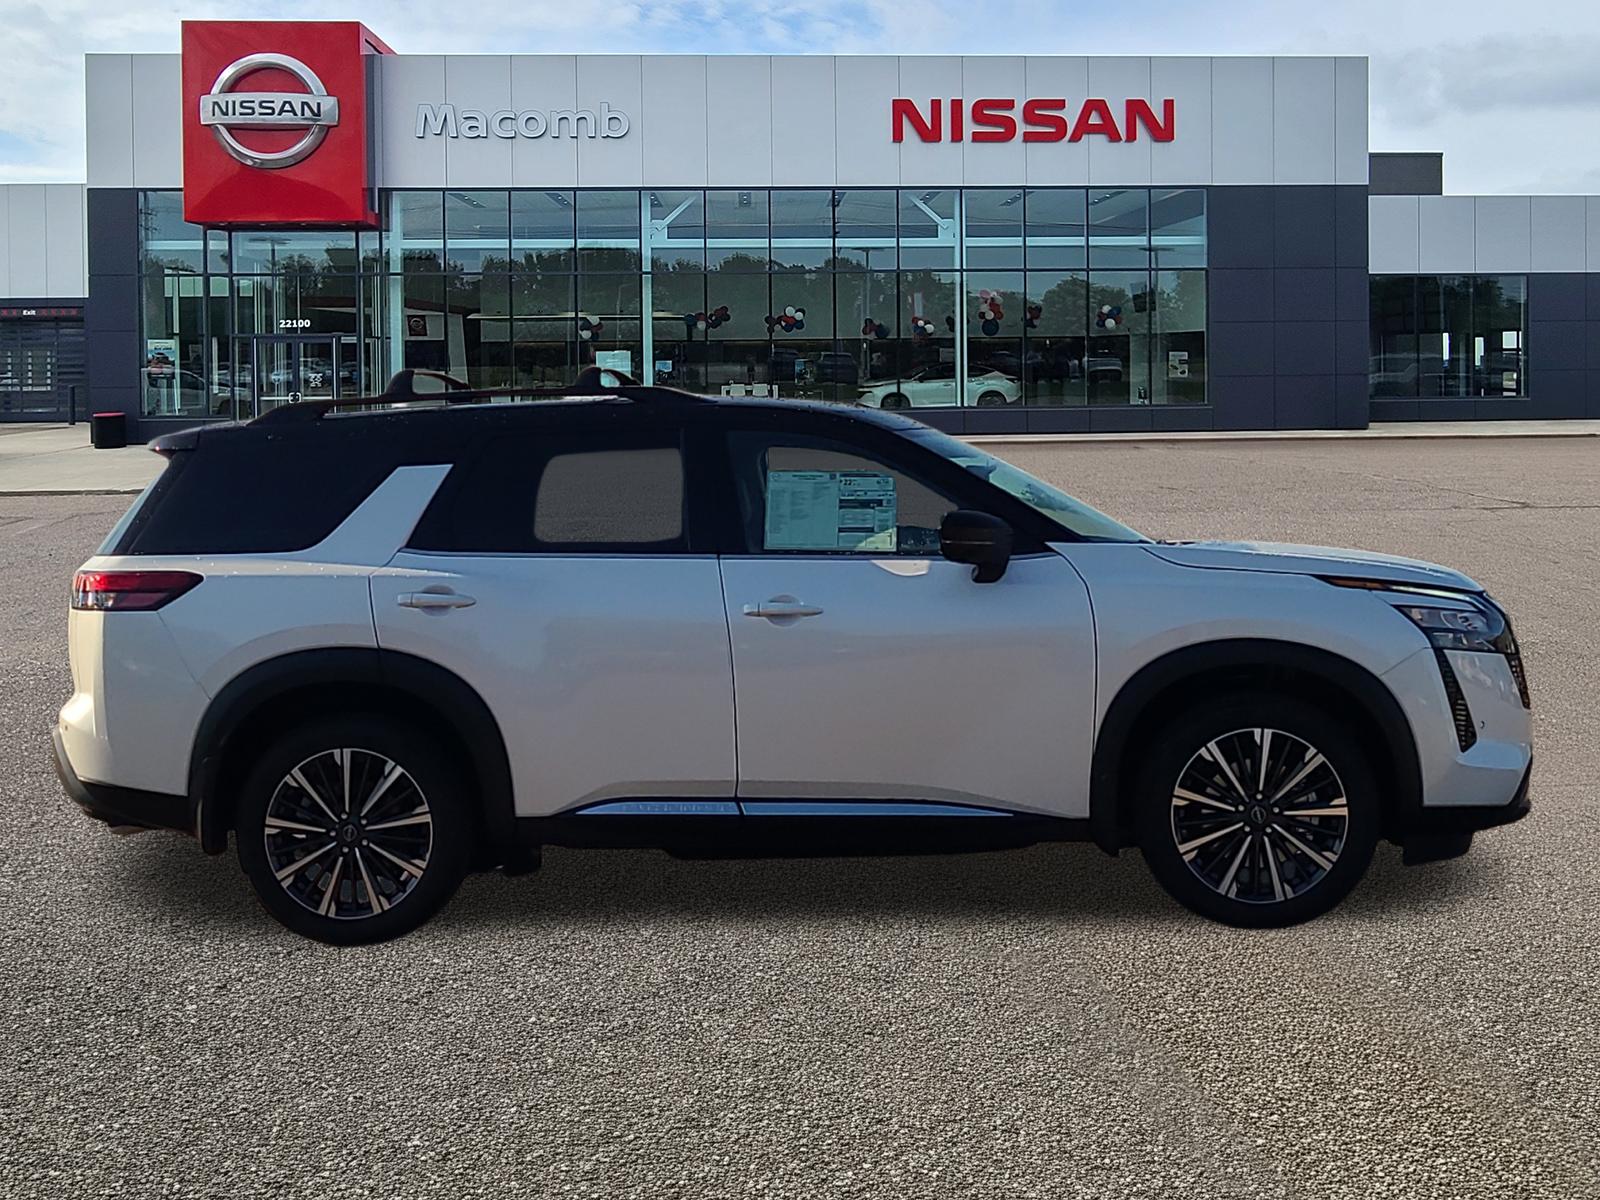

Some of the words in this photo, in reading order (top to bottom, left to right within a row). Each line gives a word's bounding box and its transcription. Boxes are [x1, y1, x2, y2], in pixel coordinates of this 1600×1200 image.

[211, 100, 322, 118] NISSAN
[415, 101, 630, 139] Macomb
[892, 98, 1175, 143] NISSAN
[279, 319, 311, 328] 22100
